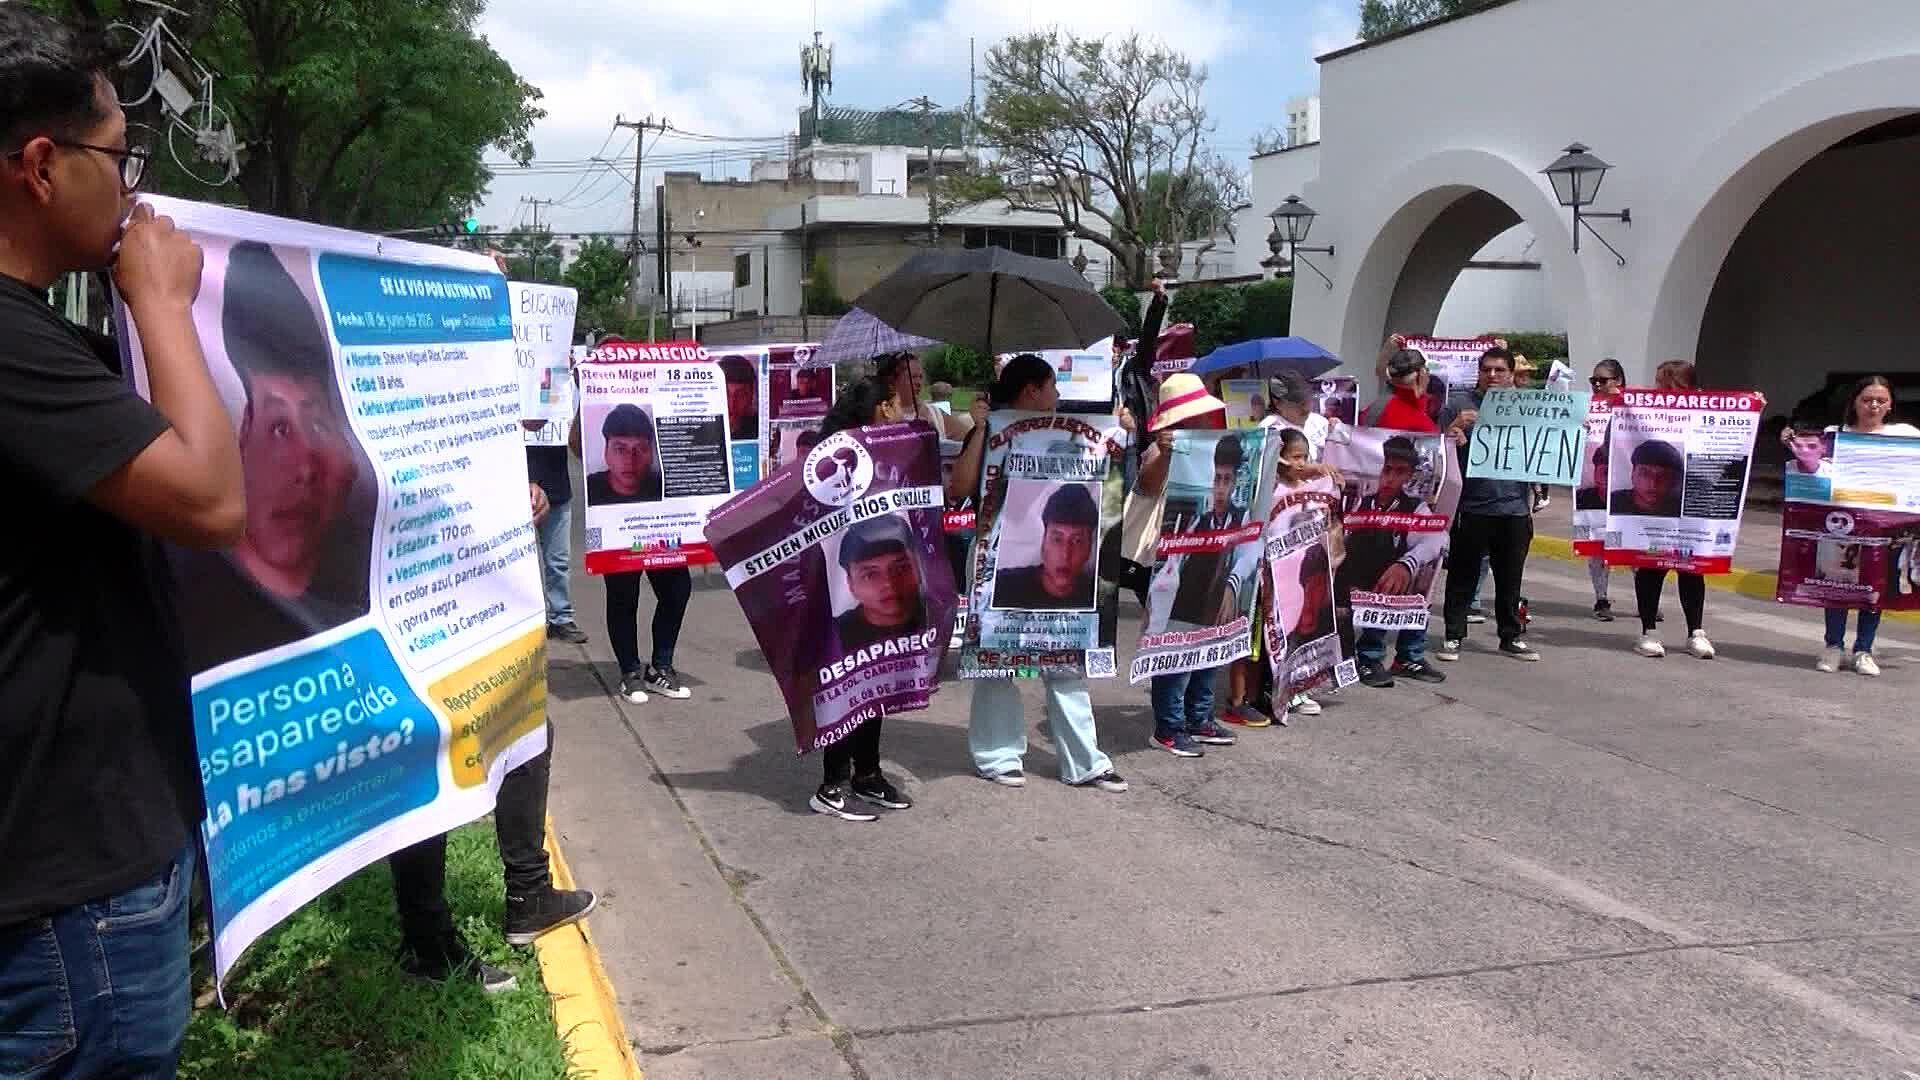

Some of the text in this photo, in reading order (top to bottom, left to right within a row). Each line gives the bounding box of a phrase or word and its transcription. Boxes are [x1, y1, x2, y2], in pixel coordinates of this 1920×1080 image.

[581, 367, 657, 382] Steven Miguel
[666, 367, 714, 381] 18 años
[1491, 390, 1575, 403] TE QUEREMOS
[1623, 392, 1752, 410] DESAPARECIDO
[1495, 405, 1571, 420] DE VUELTA
[1655, 412, 1692, 423] Miguel
[1702, 415, 1753, 427] 18 años
[1470, 423, 1581, 479] STEVEN
[1008, 453, 1036, 472] STEVEN
[440, 524, 459, 543] 170
[744, 535, 802, 577] STEVEN
[802, 510, 850, 546] MIGUEL
[853, 495, 890, 520] RÍOS
[457, 541, 490, 561] Camisa
[389, 593, 402, 609] en
[404, 583, 429, 605] color
[454, 560, 497, 588] pantalón
[403, 610, 429, 633] gorra
[1362, 609, 1378, 624] 66
[448, 622, 460, 636] La
[208, 661, 356, 737] Persona
[443, 680, 492, 713] Reporta
[826, 689, 841, 701] LA
[876, 683, 893, 697] DE
[200, 681, 398, 786] esaparecida
[236, 768, 307, 816] has
[313, 716, 415, 781] visto?
